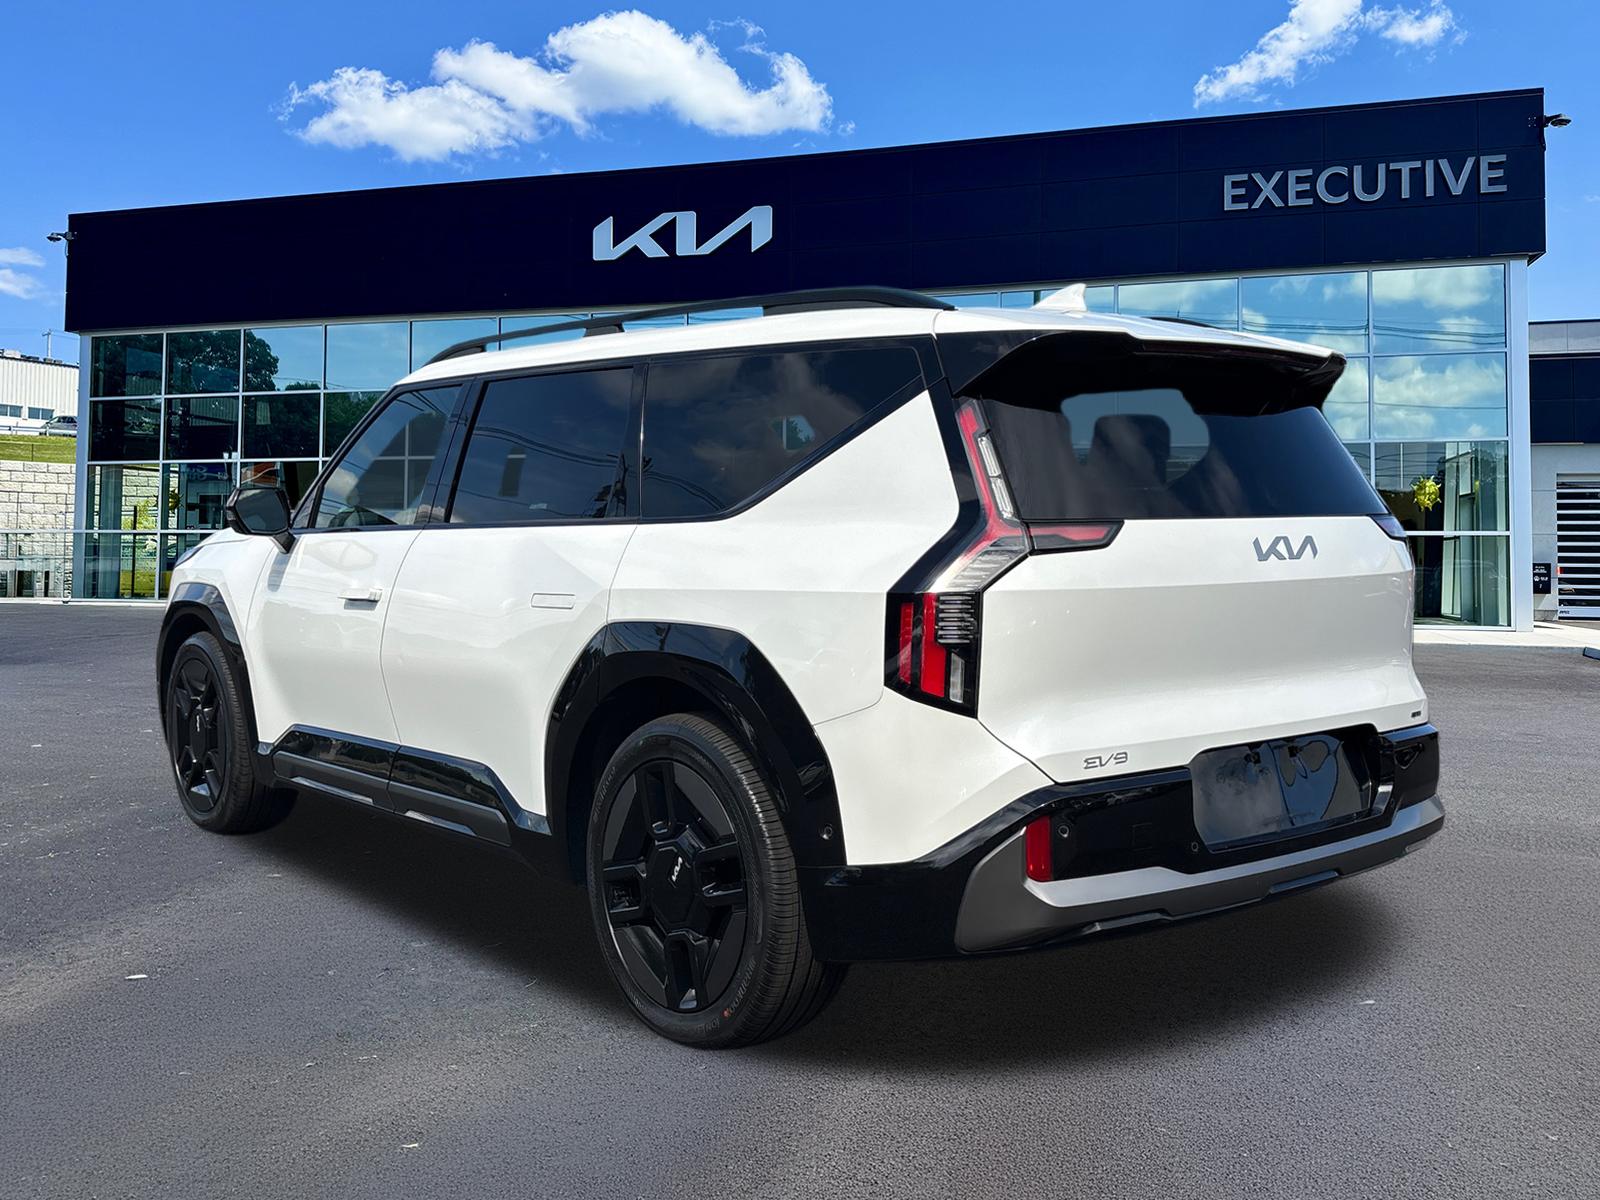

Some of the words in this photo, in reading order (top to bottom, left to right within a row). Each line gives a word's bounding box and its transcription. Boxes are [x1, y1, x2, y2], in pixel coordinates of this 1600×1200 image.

[1223, 154, 1508, 211] EXECUTIVE
[593, 205, 773, 261] KIA
[1252, 535, 1319, 562] KIA
[1083, 751, 1128, 769] EV9
